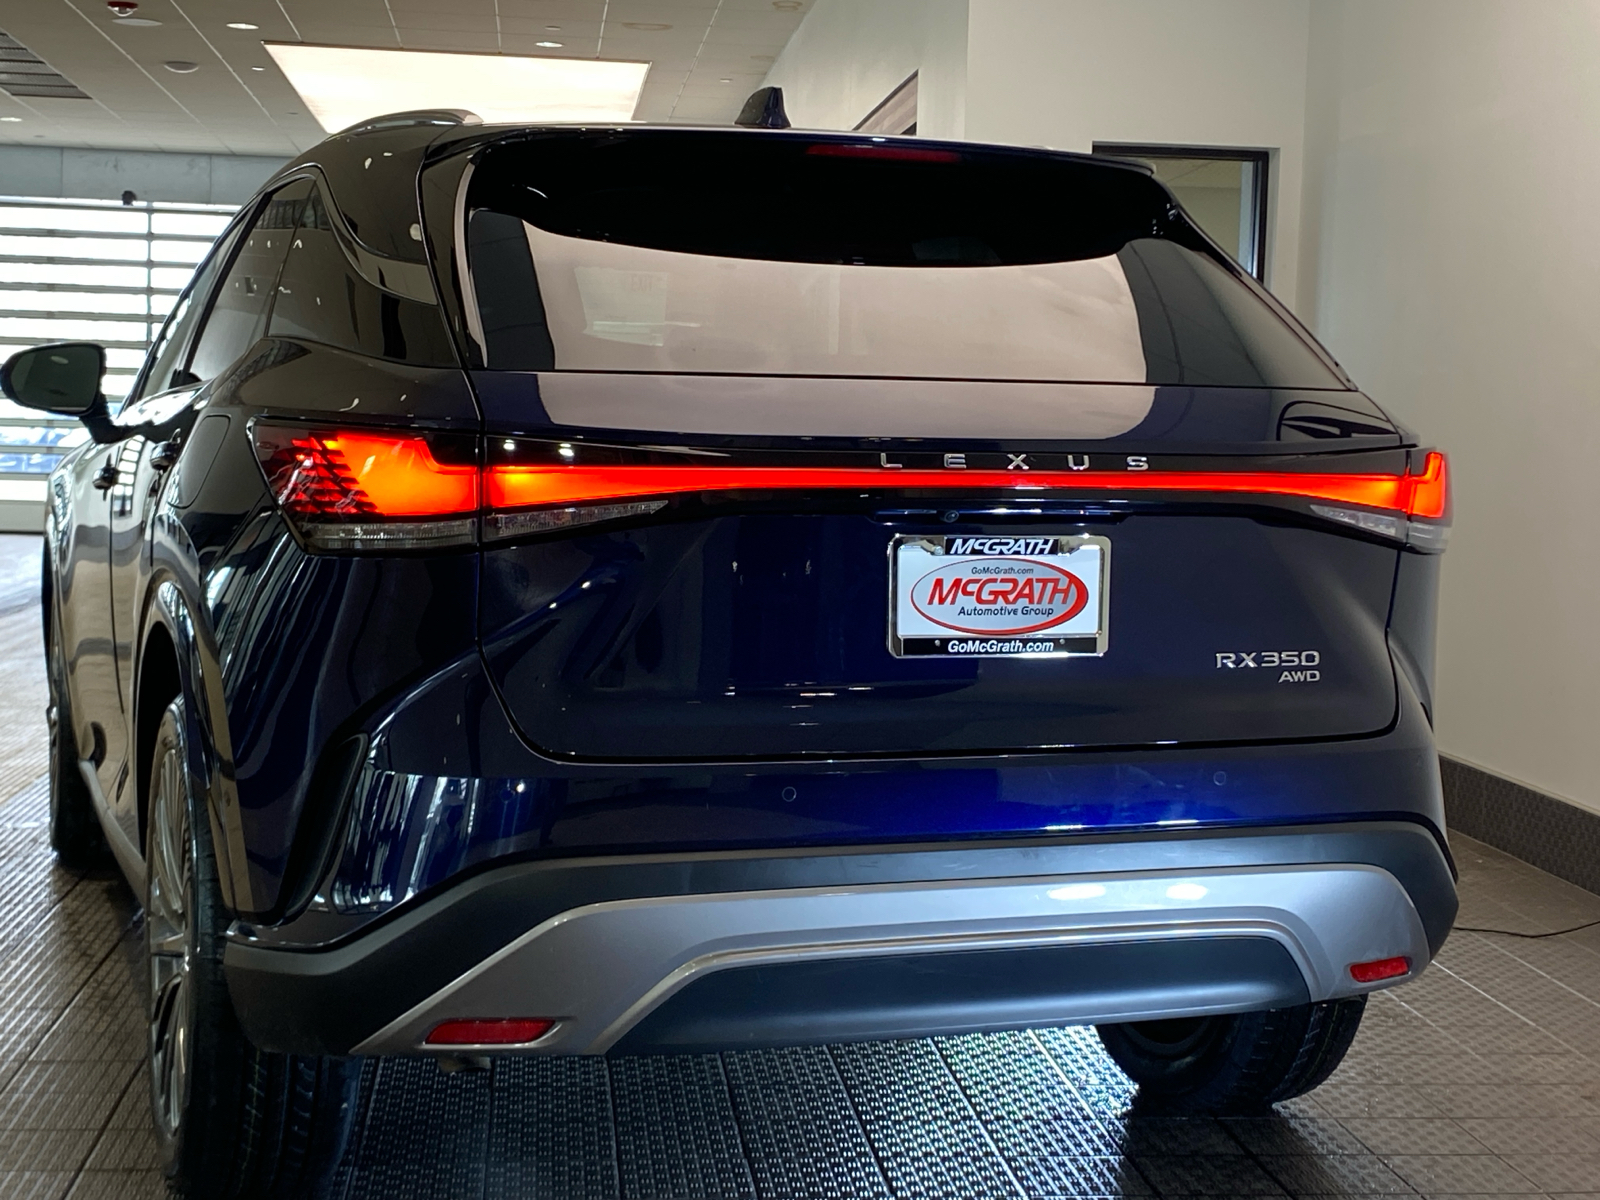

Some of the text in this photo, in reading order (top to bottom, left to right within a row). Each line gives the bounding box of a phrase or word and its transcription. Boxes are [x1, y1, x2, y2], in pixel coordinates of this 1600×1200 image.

[880, 452, 1149, 471] LEXUS
[971, 566, 1034, 575] GoMcGrath.com
[957, 605, 1054, 618] Automotive Group
[948, 639, 1054, 654] GoMcGrath.com
[1215, 650, 1320, 669] RX 350
[1278, 670, 1320, 683] AWD
